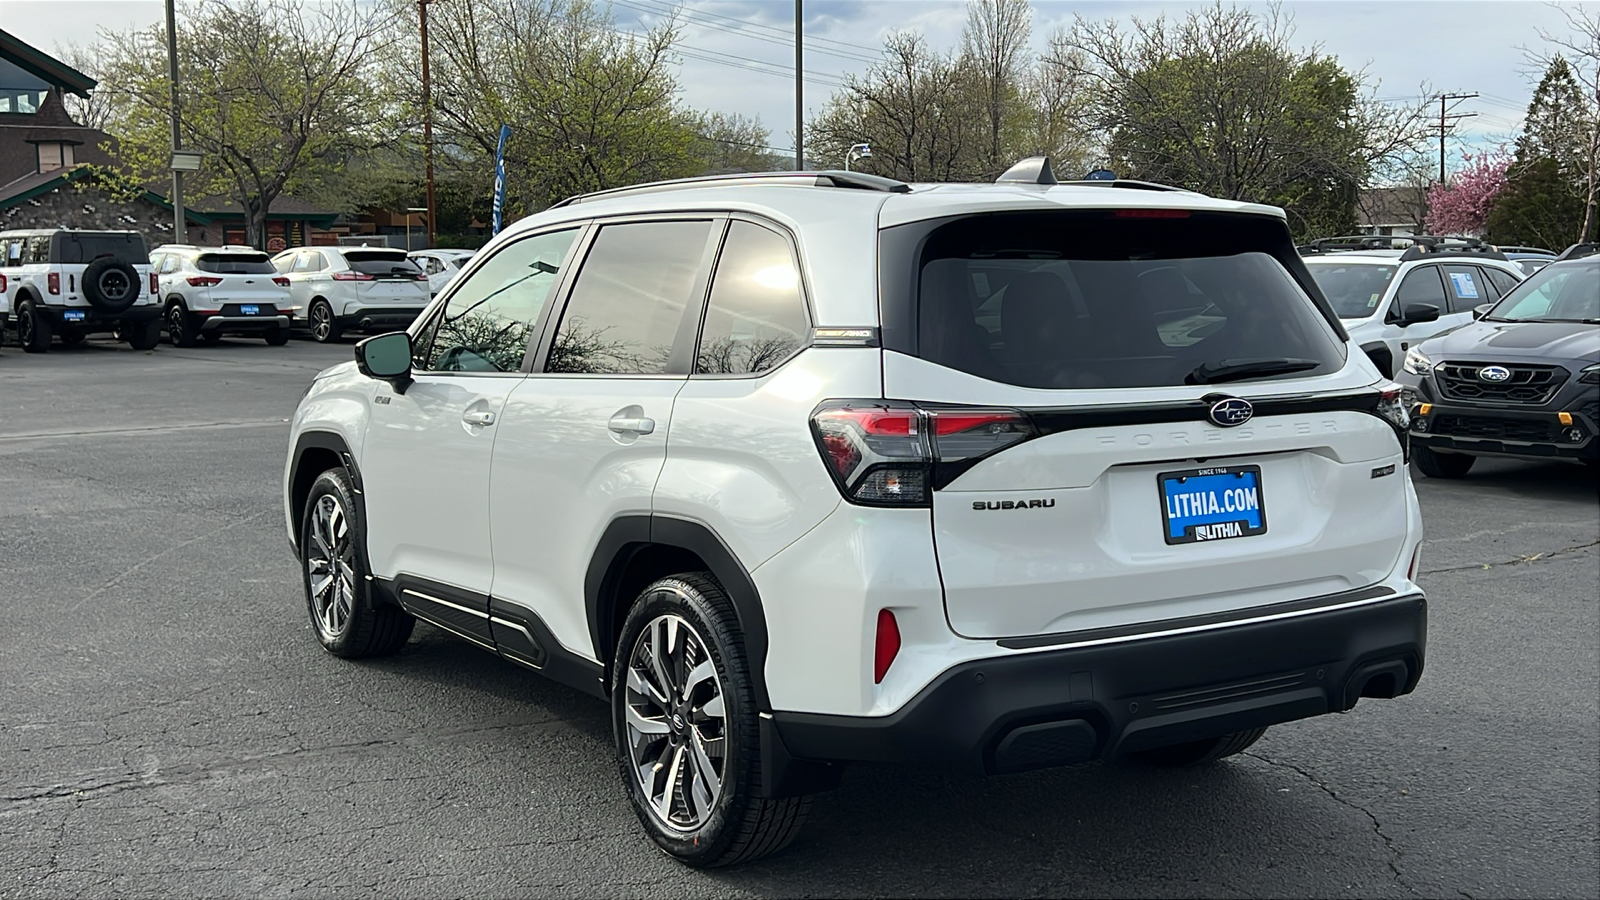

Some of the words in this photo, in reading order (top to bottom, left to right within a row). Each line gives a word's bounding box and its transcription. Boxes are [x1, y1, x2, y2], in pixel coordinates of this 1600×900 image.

[1096, 420, 1338, 446] FORESTER
[972, 498, 1055, 510] SUBARU
[1166, 487, 1259, 519] LITHIA.COM
[1206, 522, 1243, 539] LITHIA
